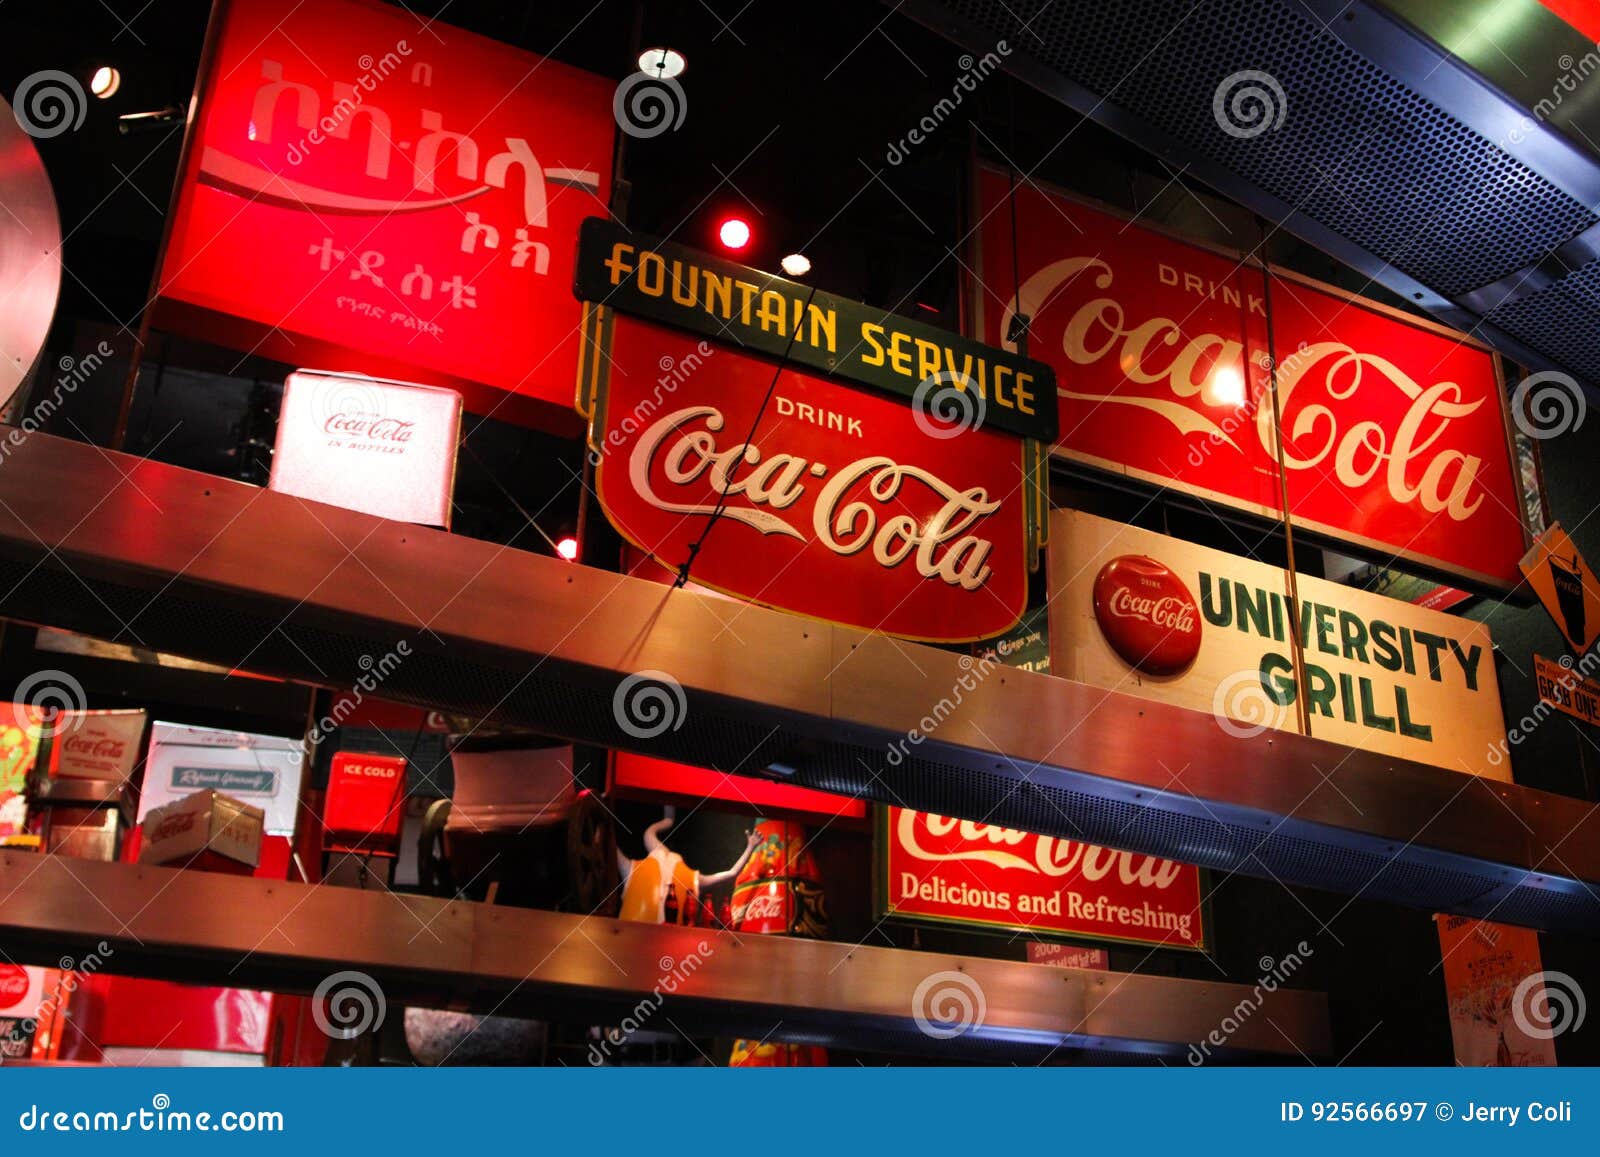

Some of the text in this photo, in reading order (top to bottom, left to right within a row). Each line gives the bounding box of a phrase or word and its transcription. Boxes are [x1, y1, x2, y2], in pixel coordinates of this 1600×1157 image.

[604, 242, 1036, 416] FOUNTAIN SERVICE
[1159, 263, 1268, 318] DRINK
[775, 396, 864, 438] DRINK
[1000, 256, 1487, 522] Coca-Cola
[628, 405, 1001, 592] Coca-Cola
[1110, 586, 1195, 634] Coca-Cola
[1199, 571, 1483, 692] UNIVERSITY
[1259, 652, 1433, 743] GRILL
[344, 763, 396, 778] ICE COLD
[901, 872, 1192, 940] Delicious and Refreshing
